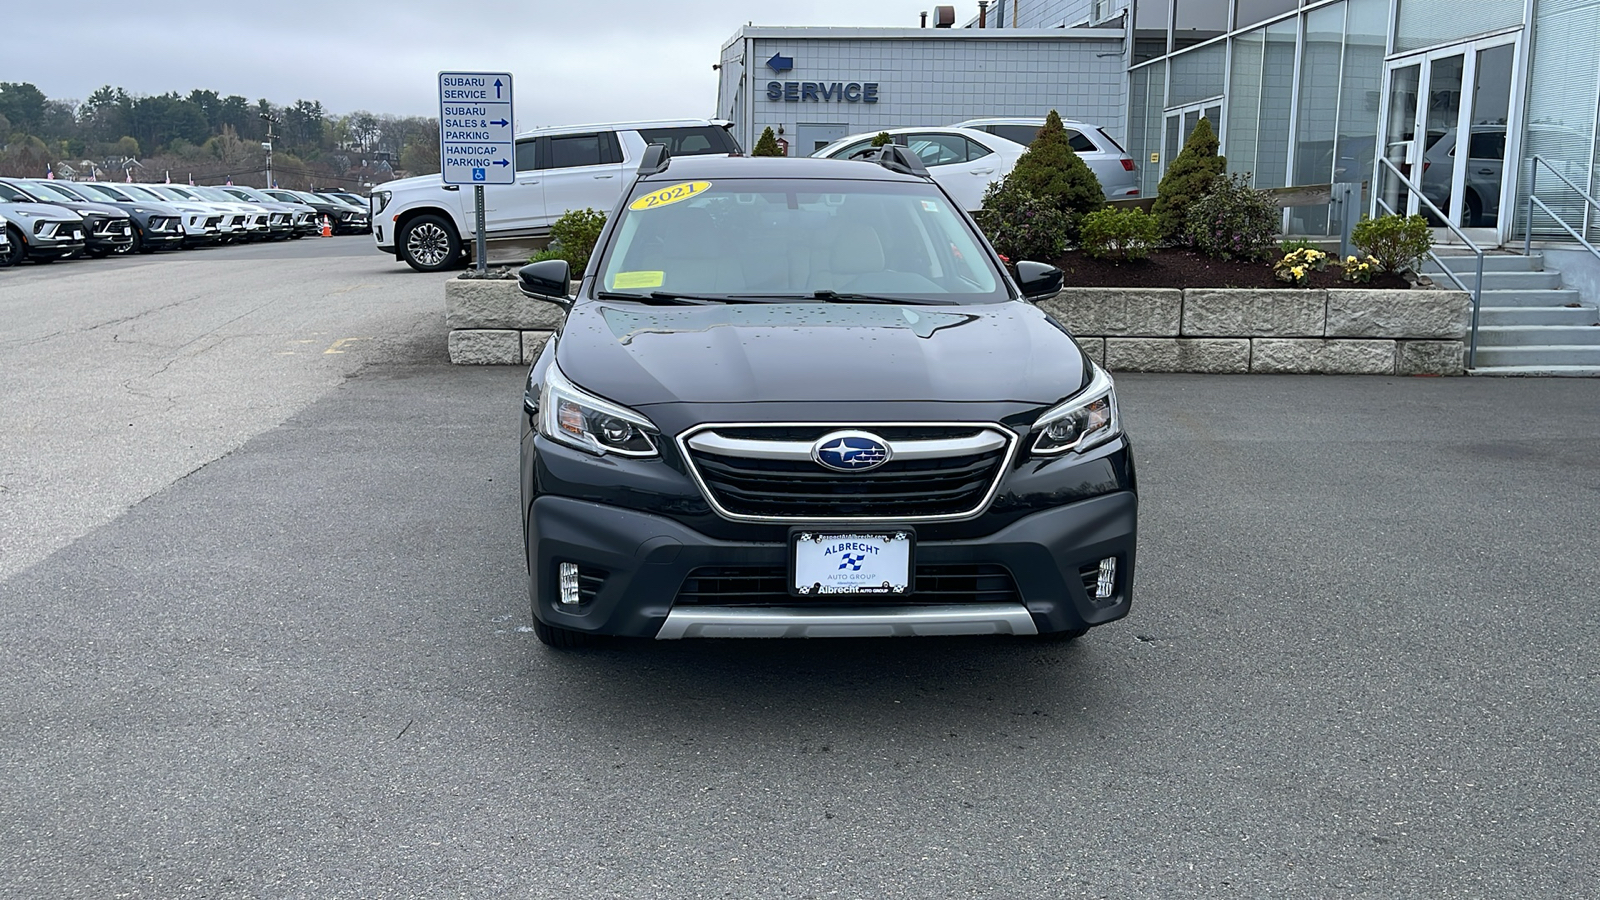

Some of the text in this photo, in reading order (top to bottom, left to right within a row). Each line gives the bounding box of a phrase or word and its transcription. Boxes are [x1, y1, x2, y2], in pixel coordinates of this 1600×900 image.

[443, 78, 485, 87] SUBARU
[444, 90, 487, 99] SERVICE
[766, 81, 879, 103] SERVICE
[445, 107, 486, 116] SUBARU
[445, 119, 487, 128] SALES &
[446, 131, 490, 140] PARKING
[446, 146, 497, 155] HANDICAP
[447, 158, 491, 167] PARKING
[645, 183, 698, 207] 2021
[824, 542, 880, 556] ALBRECHT
[817, 584, 860, 594] Albrecht
